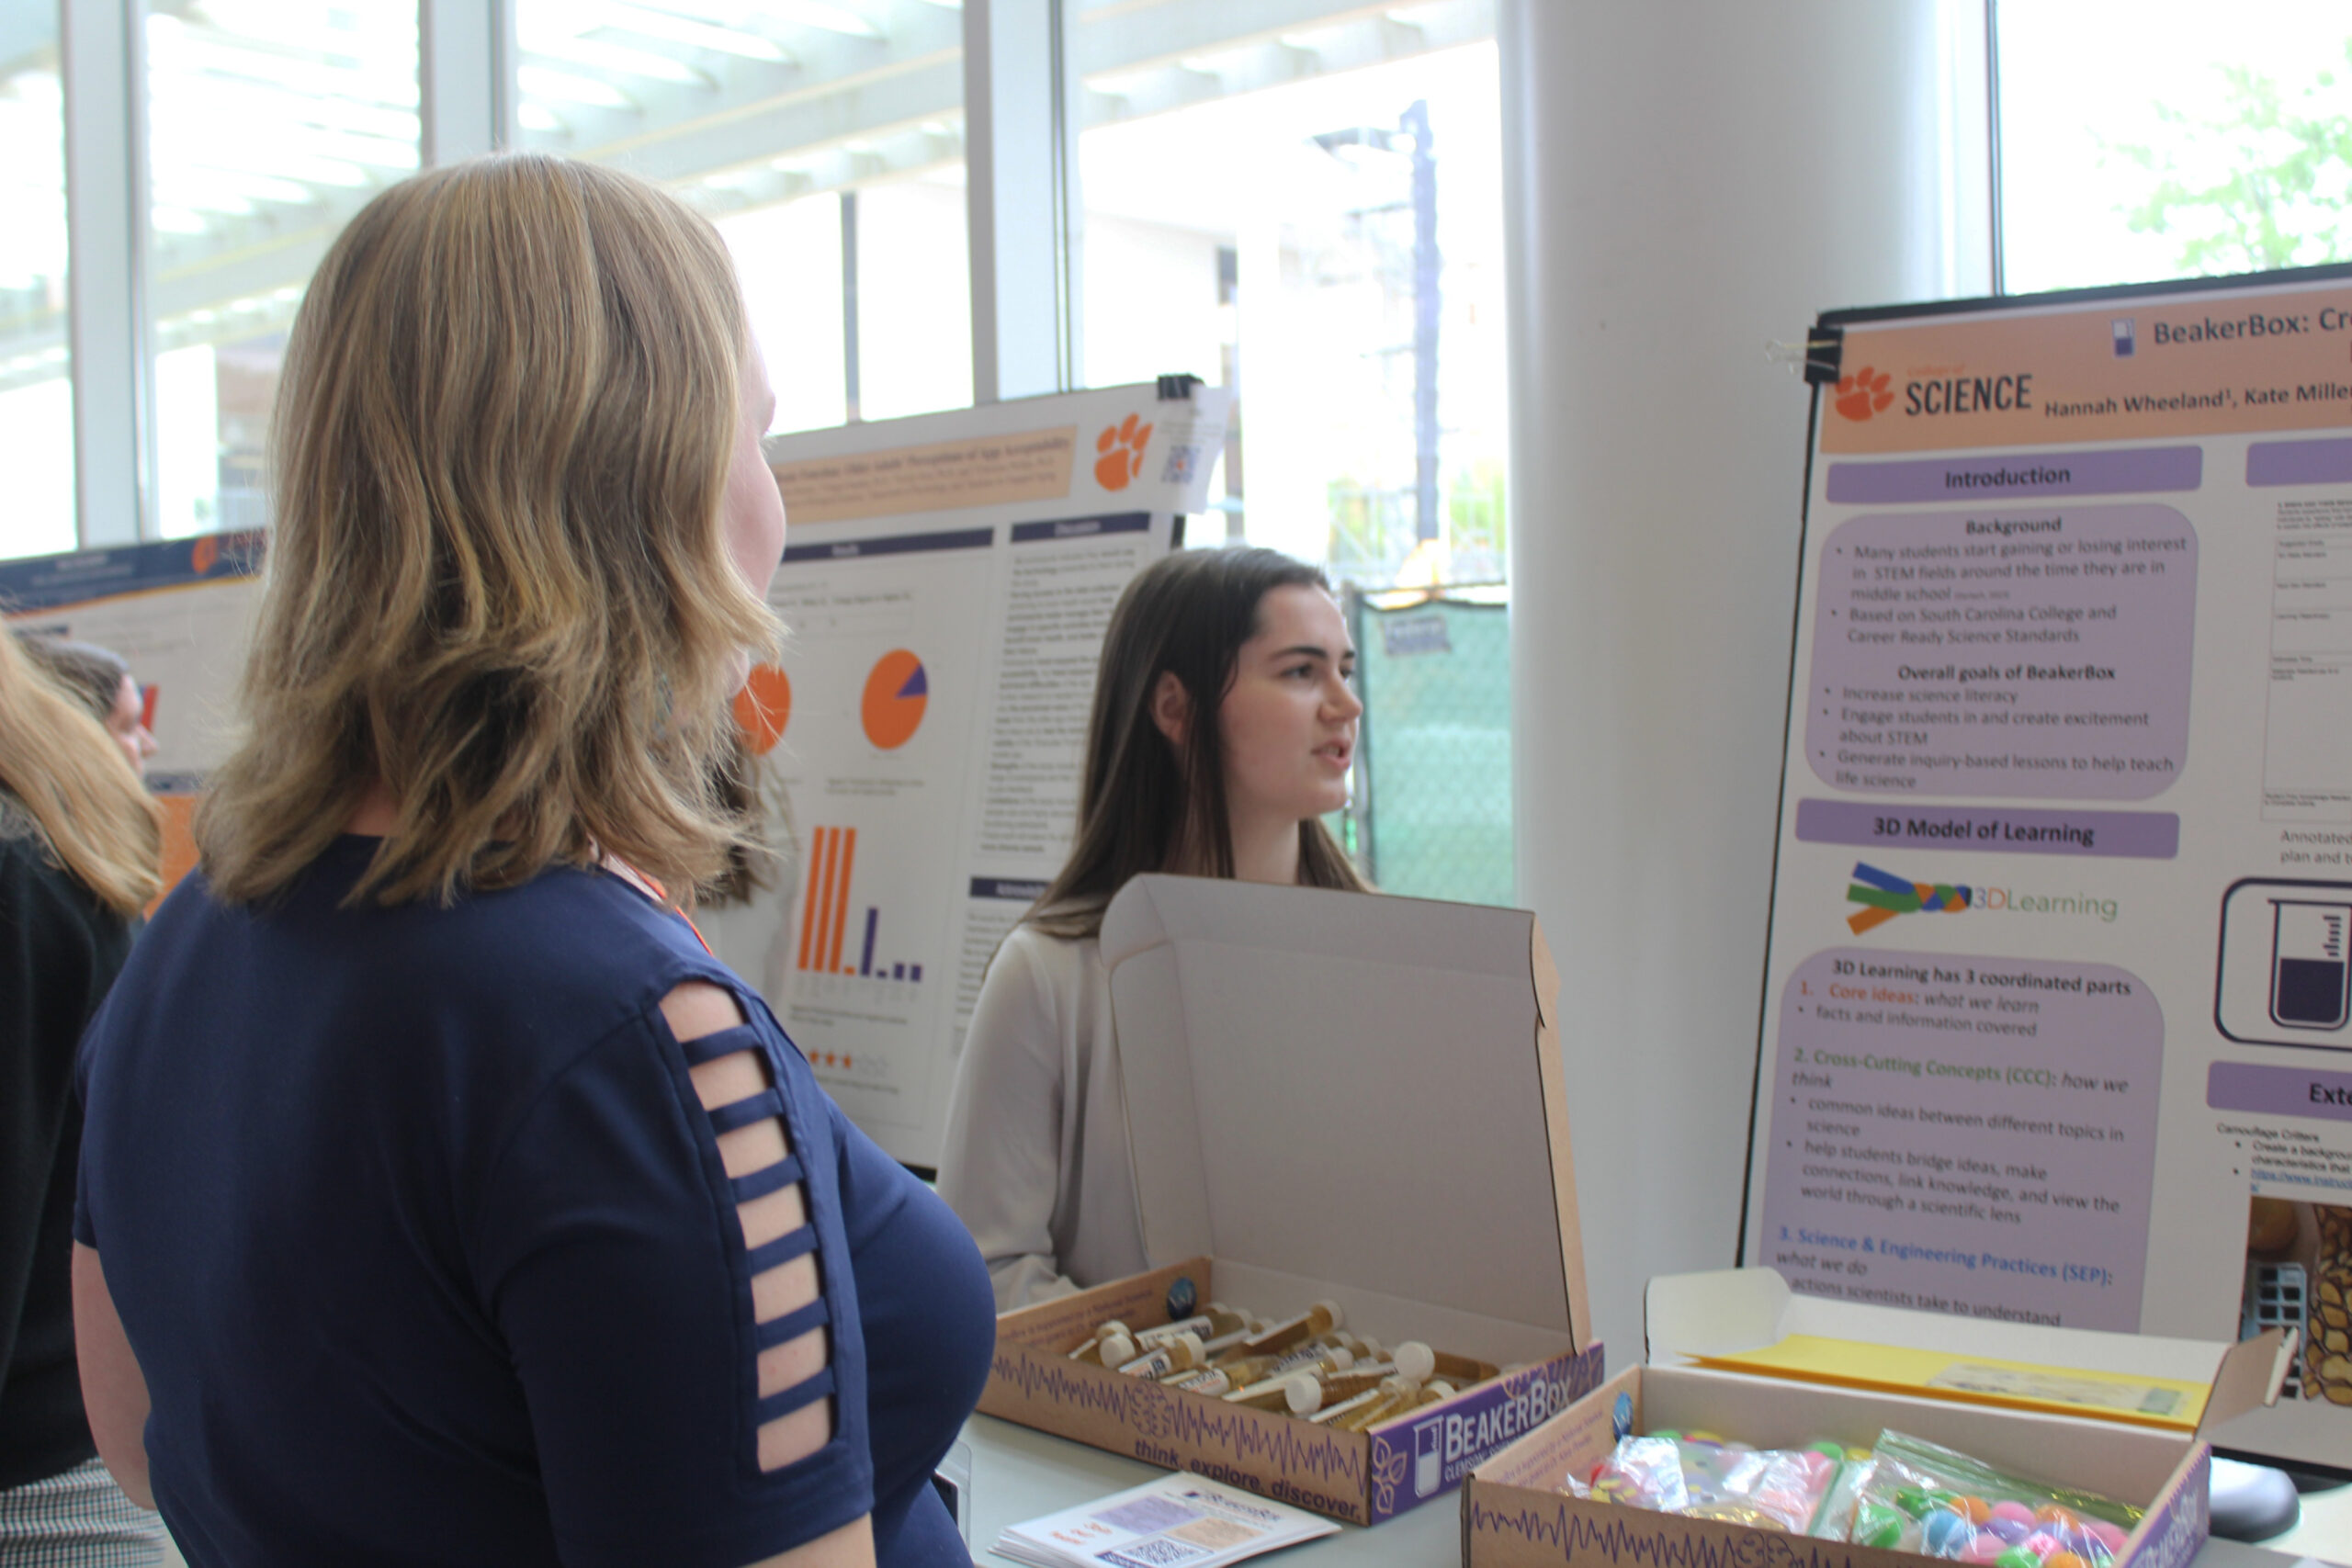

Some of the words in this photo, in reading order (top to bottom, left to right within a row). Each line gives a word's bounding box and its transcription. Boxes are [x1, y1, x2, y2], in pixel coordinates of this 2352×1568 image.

[2154, 312, 2309, 344] BeakerBox:
[2319, 307, 2352, 332] Cr
[1905, 373, 2032, 416] SCIENCE
[2044, 397, 2117, 418] Hannah
[2245, 386, 2290, 405] Kate
[2296, 381, 2352, 402] Mille
[1945, 466, 2071, 489] Introduction
[1965, 516, 2062, 536] Background
[1854, 545, 1894, 562] Many
[1899, 544, 1960, 558] students
[1963, 543, 1996, 558] start
[2000, 540, 2053, 558] gaining
[2057, 542, 2074, 554] or
[2077, 537, 2123, 555] losing
[2127, 536, 2187, 552] interest
[1852, 567, 1866, 581] in
[1874, 566, 1916, 581] STEM
[1918, 565, 1957, 580] fields
[1960, 563, 2013, 579] around
[2015, 562, 2041, 578] the
[2044, 561, 2079, 577] time
[2083, 560, 2118, 579] they
[2120, 562, 2147, 575] are
[2151, 560, 2165, 574] in
[1850, 586, 1901, 601] middle
[1904, 586, 1951, 601] school
[1849, 607, 1894, 623] Based
[1897, 610, 1916, 622] on
[1918, 607, 1962, 623] South
[1964, 606, 2024, 622] Carolina
[2028, 604, 2084, 623] College
[2087, 604, 2117, 620] and
[1847, 629, 1896, 644] Career
[1900, 629, 1943, 646] Ready
[1947, 629, 2002, 644] Science
[2005, 627, 2081, 642] Standards
[1897, 664, 1956, 682] Overall
[1958, 664, 2001, 683] goals
[2005, 664, 2023, 681] of
[2027, 664, 2116, 681] BeakerBox
[1842, 688, 1905, 703] Increase
[1908, 689, 1961, 704] science
[1964, 689, 2019, 705] literacy
[1840, 707, 1894, 726] Engage
[1898, 710, 1961, 726] students
[1962, 711, 1978, 725] in
[1981, 710, 2009, 725] and
[2012, 712, 2060, 727] create
[2064, 712, 2150, 727] excitement
[1838, 729, 1883, 745] about
[1887, 731, 1928, 746] STEM
[1837, 750, 1906, 767] Generate
[1910, 753, 2009, 770] inquiry-based
[2012, 753, 2068, 769] lessons
[2072, 757, 2089, 771] to
[2091, 755, 2126, 773] help
[2130, 756, 2175, 773] teach
[1835, 771, 1859, 784] life
[1862, 773, 1917, 789] science
[1872, 818, 1902, 836] 3D
[1906, 818, 1972, 839] Model
[1976, 820, 1999, 840] of
[2004, 822, 2095, 849] Learning
[2279, 849, 2310, 864] plan
[2313, 850, 2341, 864] and
[1973, 886, 2119, 922] 3DLearning
[1831, 960, 1856, 976] 3D
[1859, 961, 1929, 984] Learning
[1932, 966, 1961, 984] has
[1965, 968, 1975, 984] 3
[1979, 971, 2083, 992] coordinated
[2086, 980, 2132, 997] parts
[1829, 983, 1868, 1000] Core
[1924, 991, 1965, 1010] what
[1969, 997, 1993, 1010] we
[1996, 996, 2040, 1014] learn
[1815, 1005, 1850, 1021] facts
[1855, 1009, 1883, 1025] and
[1886, 1011, 1973, 1032] information
[1976, 1020, 2038, 1037] covered
[1792, 1071, 1832, 1089] think
[1814, 1049, 1922, 1077] Cross-Cutting
[1926, 1060, 2001, 1082] Concepts
[2061, 1072, 2099, 1090] how
[2103, 1077, 2130, 1093] we
[1806, 1120, 1860, 1137] science
[1808, 1099, 1873, 1117] common
[1877, 1103, 1915, 1121] ideas
[1918, 1107, 1983, 1128] between
[1987, 1113, 2053, 1134] different
[2057, 1122, 2105, 1141] topics
[2109, 1126, 2124, 1142] in
[1804, 1140, 1837, 1158] help
[1840, 1145, 1903, 1165] students
[1906, 1152, 1952, 1172] bridge
[2006, 1163, 2047, 1180] make
[1801, 1186, 1842, 1201] world
[1846, 1188, 1904, 1211] through
[1907, 1198, 1917, 1210] a
[1920, 1198, 1986, 1220] scientific
[1989, 1206, 2021, 1224] lens
[1898, 1172, 1924, 1189] link
[2018, 1189, 2048, 1204] and
[2052, 1192, 2089, 1208] view
[2093, 1196, 2120, 1213] the
[1776, 1251, 1816, 1269] what
[1821, 1258, 1843, 1272] we
[1846, 1259, 1868, 1277] do
[1798, 1228, 1858, 1251] Science
[1861, 1235, 1874, 1252] &
[1880, 1238, 1977, 1270] Engineering
[1982, 1252, 2058, 1278] Practices
[1846, 1285, 1914, 1307] scientists
[1917, 1293, 1950, 1311] take
[1953, 1299, 1969, 1314] to
[1972, 1303, 2062, 1327] understand
